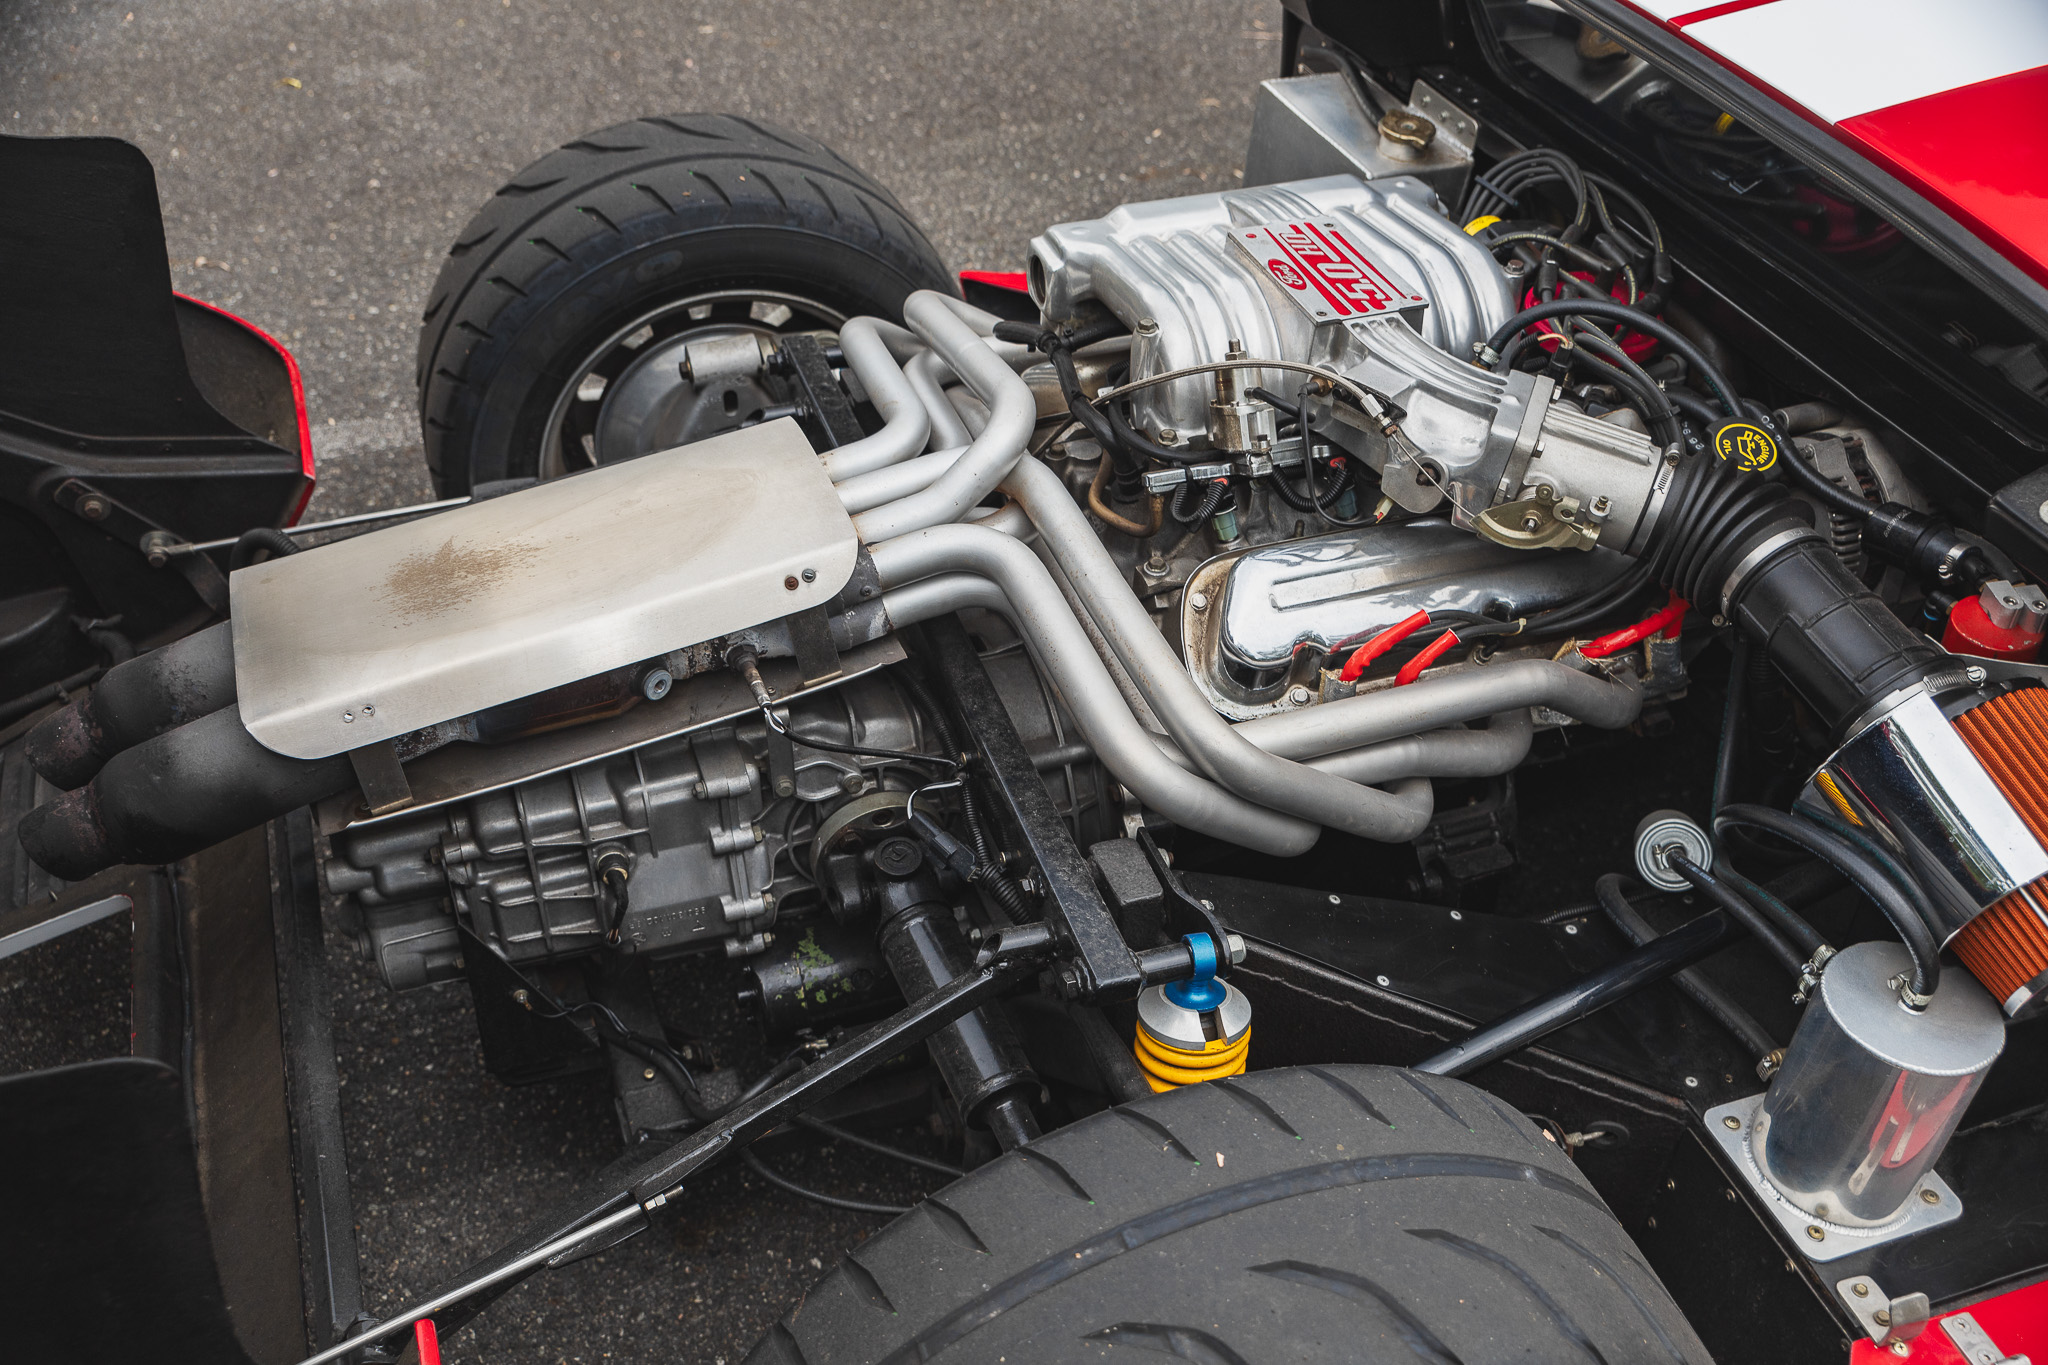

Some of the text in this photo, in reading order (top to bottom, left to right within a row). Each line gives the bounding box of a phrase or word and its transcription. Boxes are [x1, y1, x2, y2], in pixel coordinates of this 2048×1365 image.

[1273, 263, 1304, 288] Ford
[1722, 439, 1733, 455] OIL
[1753, 434, 1770, 465] ENGINE
